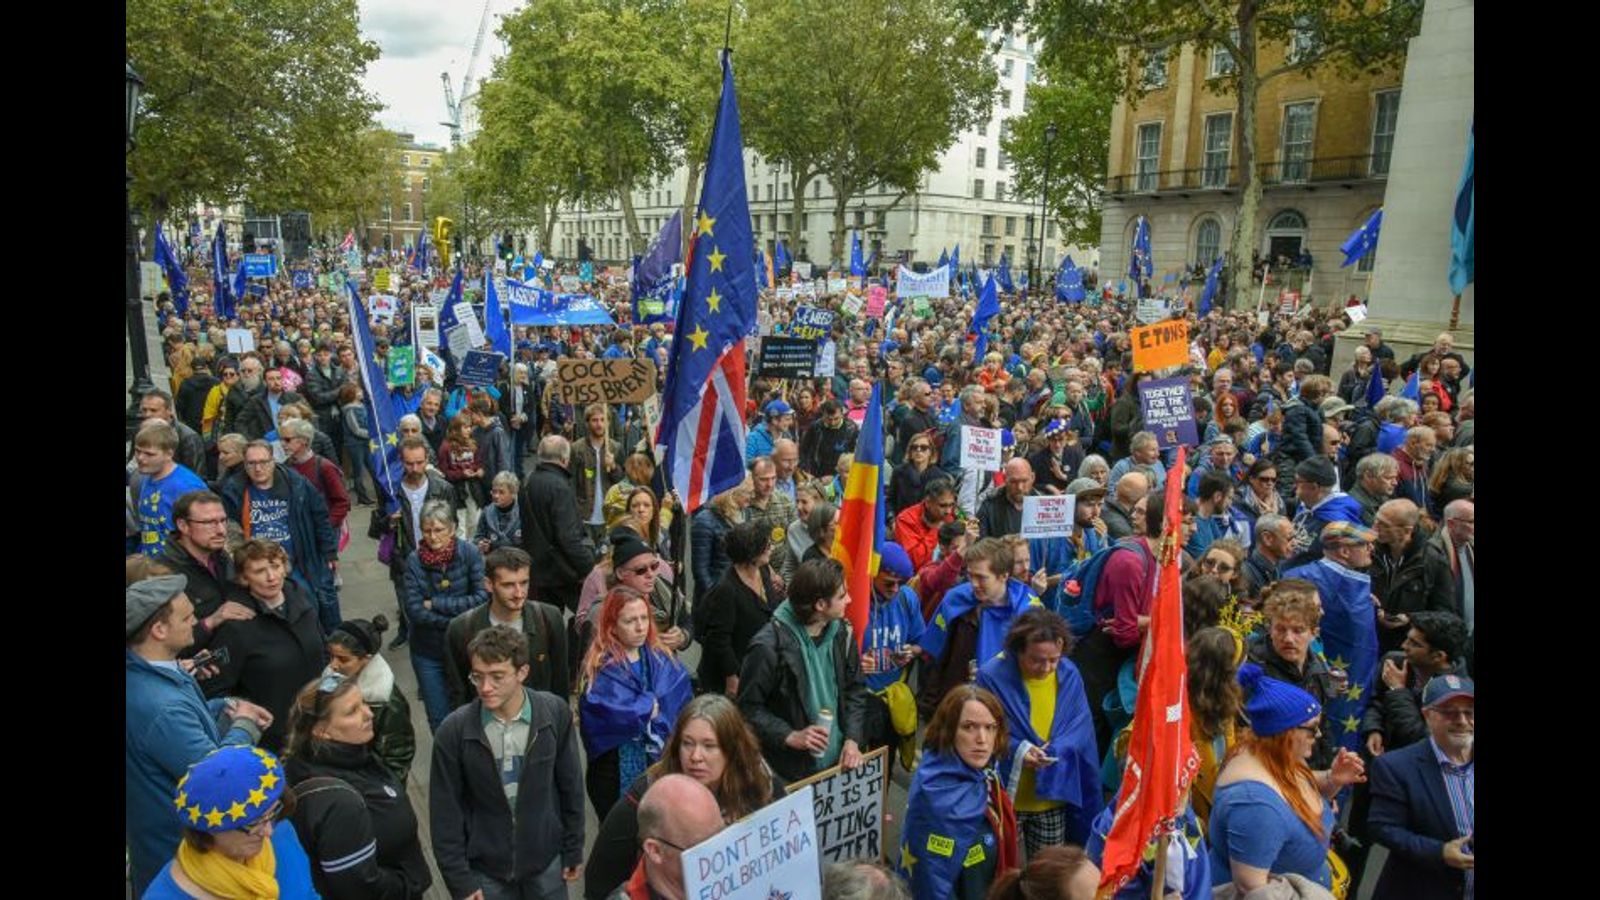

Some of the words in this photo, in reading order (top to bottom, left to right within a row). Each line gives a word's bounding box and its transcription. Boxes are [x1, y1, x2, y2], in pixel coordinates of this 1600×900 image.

[559, 360, 616, 383] COCK
[562, 382, 600, 404] PISS
[600, 358, 648, 401] BREXIT
[1144, 385, 1185, 399] TOGETHER
[1149, 397, 1166, 409] FOR
[1167, 396, 1185, 406] THE
[841, 756, 882, 786] JUST
[814, 796, 835, 820] OR
[841, 784, 862, 808] IS
[867, 775, 883, 797] IT
[759, 818, 780, 848] BE
[786, 809, 802, 833] A
[816, 801, 877, 848] TTING
[823, 829, 879, 862] TTER
